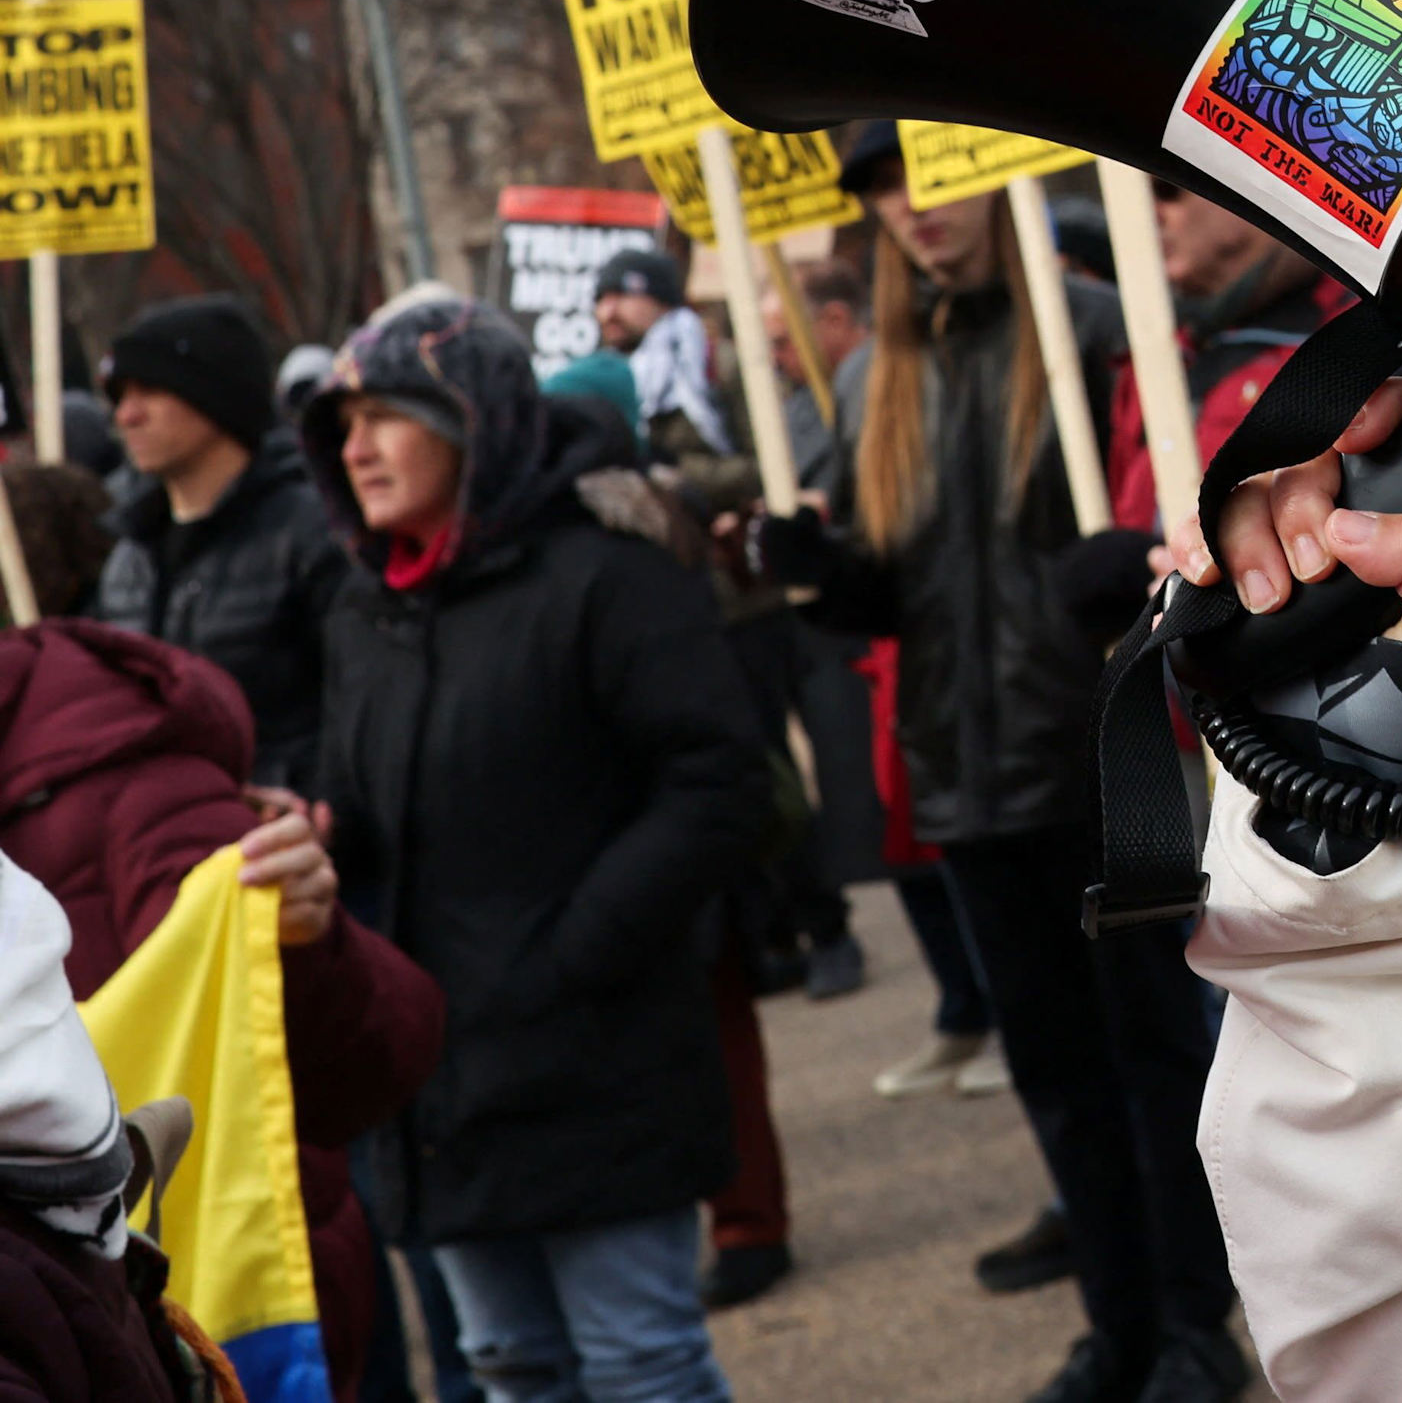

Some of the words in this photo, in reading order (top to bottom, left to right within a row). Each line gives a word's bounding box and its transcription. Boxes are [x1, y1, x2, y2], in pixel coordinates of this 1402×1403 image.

[1194, 96, 1255, 145] NOT
[1258, 140, 1316, 188] THE
[1319, 183, 1386, 242] WAR!
